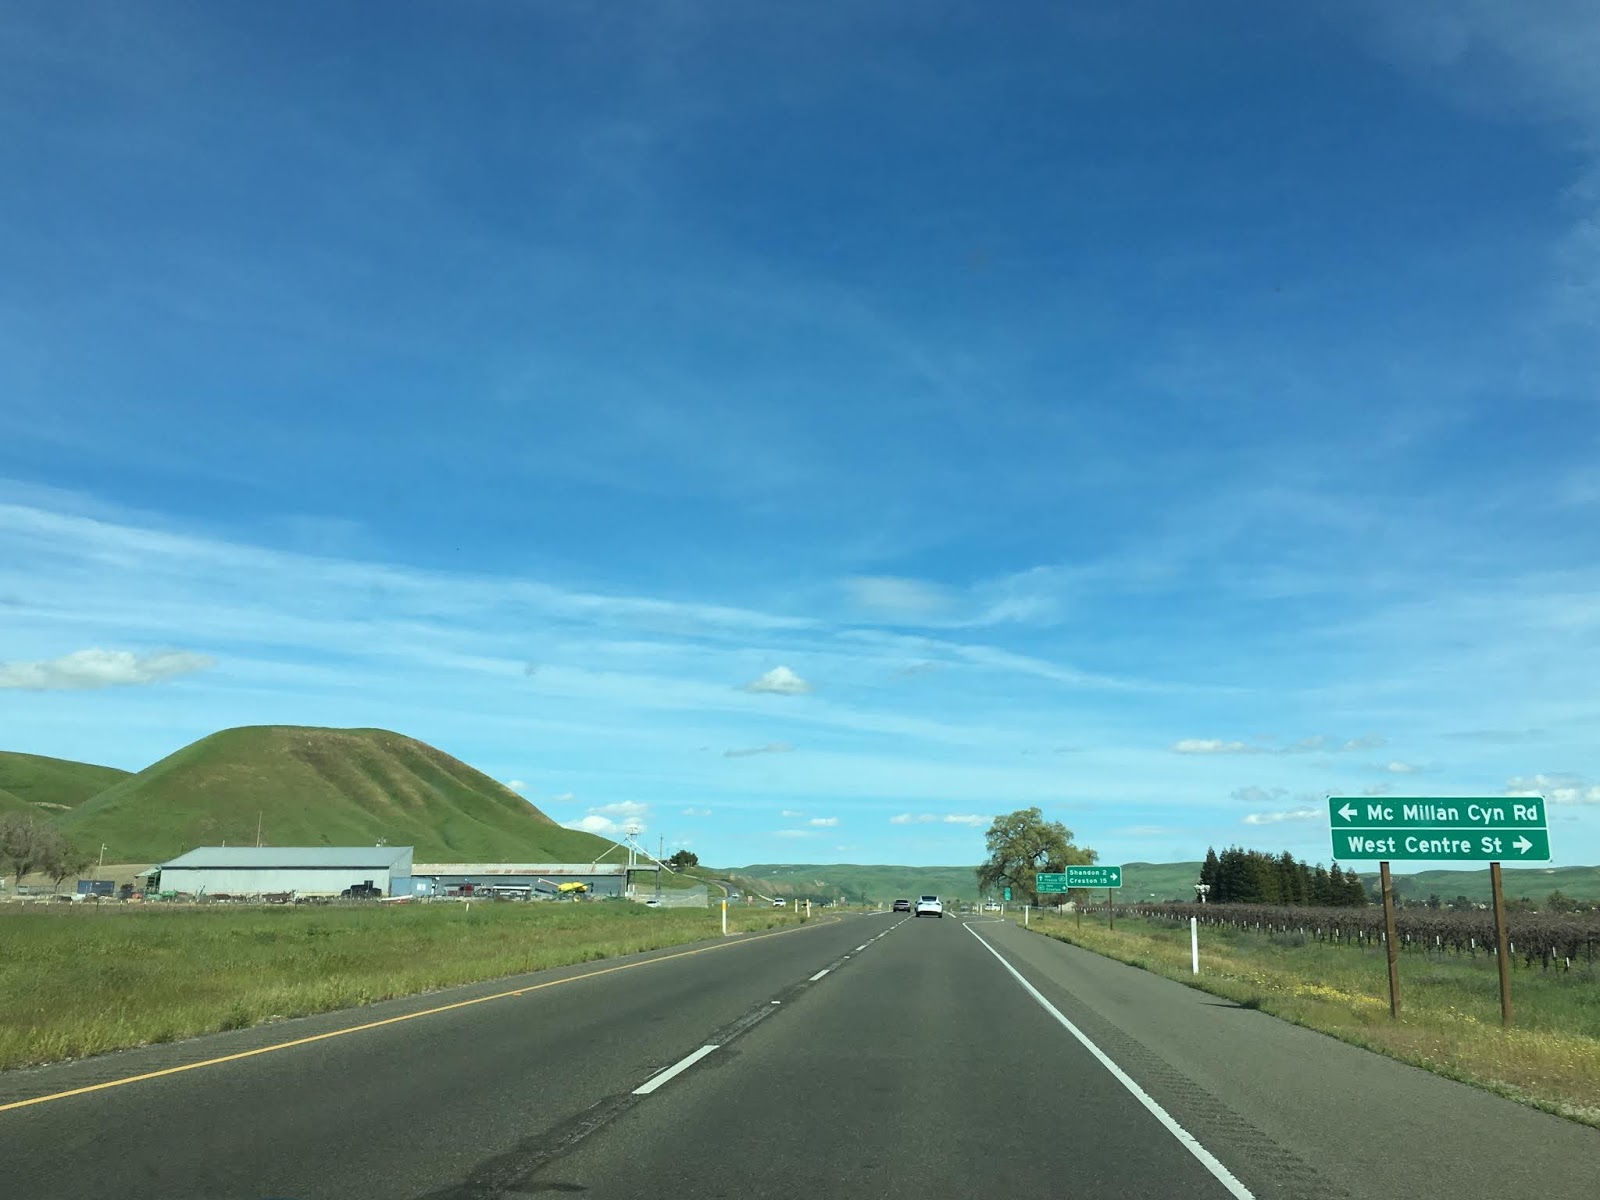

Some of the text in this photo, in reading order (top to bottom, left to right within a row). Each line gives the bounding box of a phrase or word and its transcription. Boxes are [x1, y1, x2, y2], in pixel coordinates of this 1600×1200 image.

[1367, 804, 1538, 825] Mc Millan Cyn Rd
[1347, 836, 1503, 853] West Centre St
